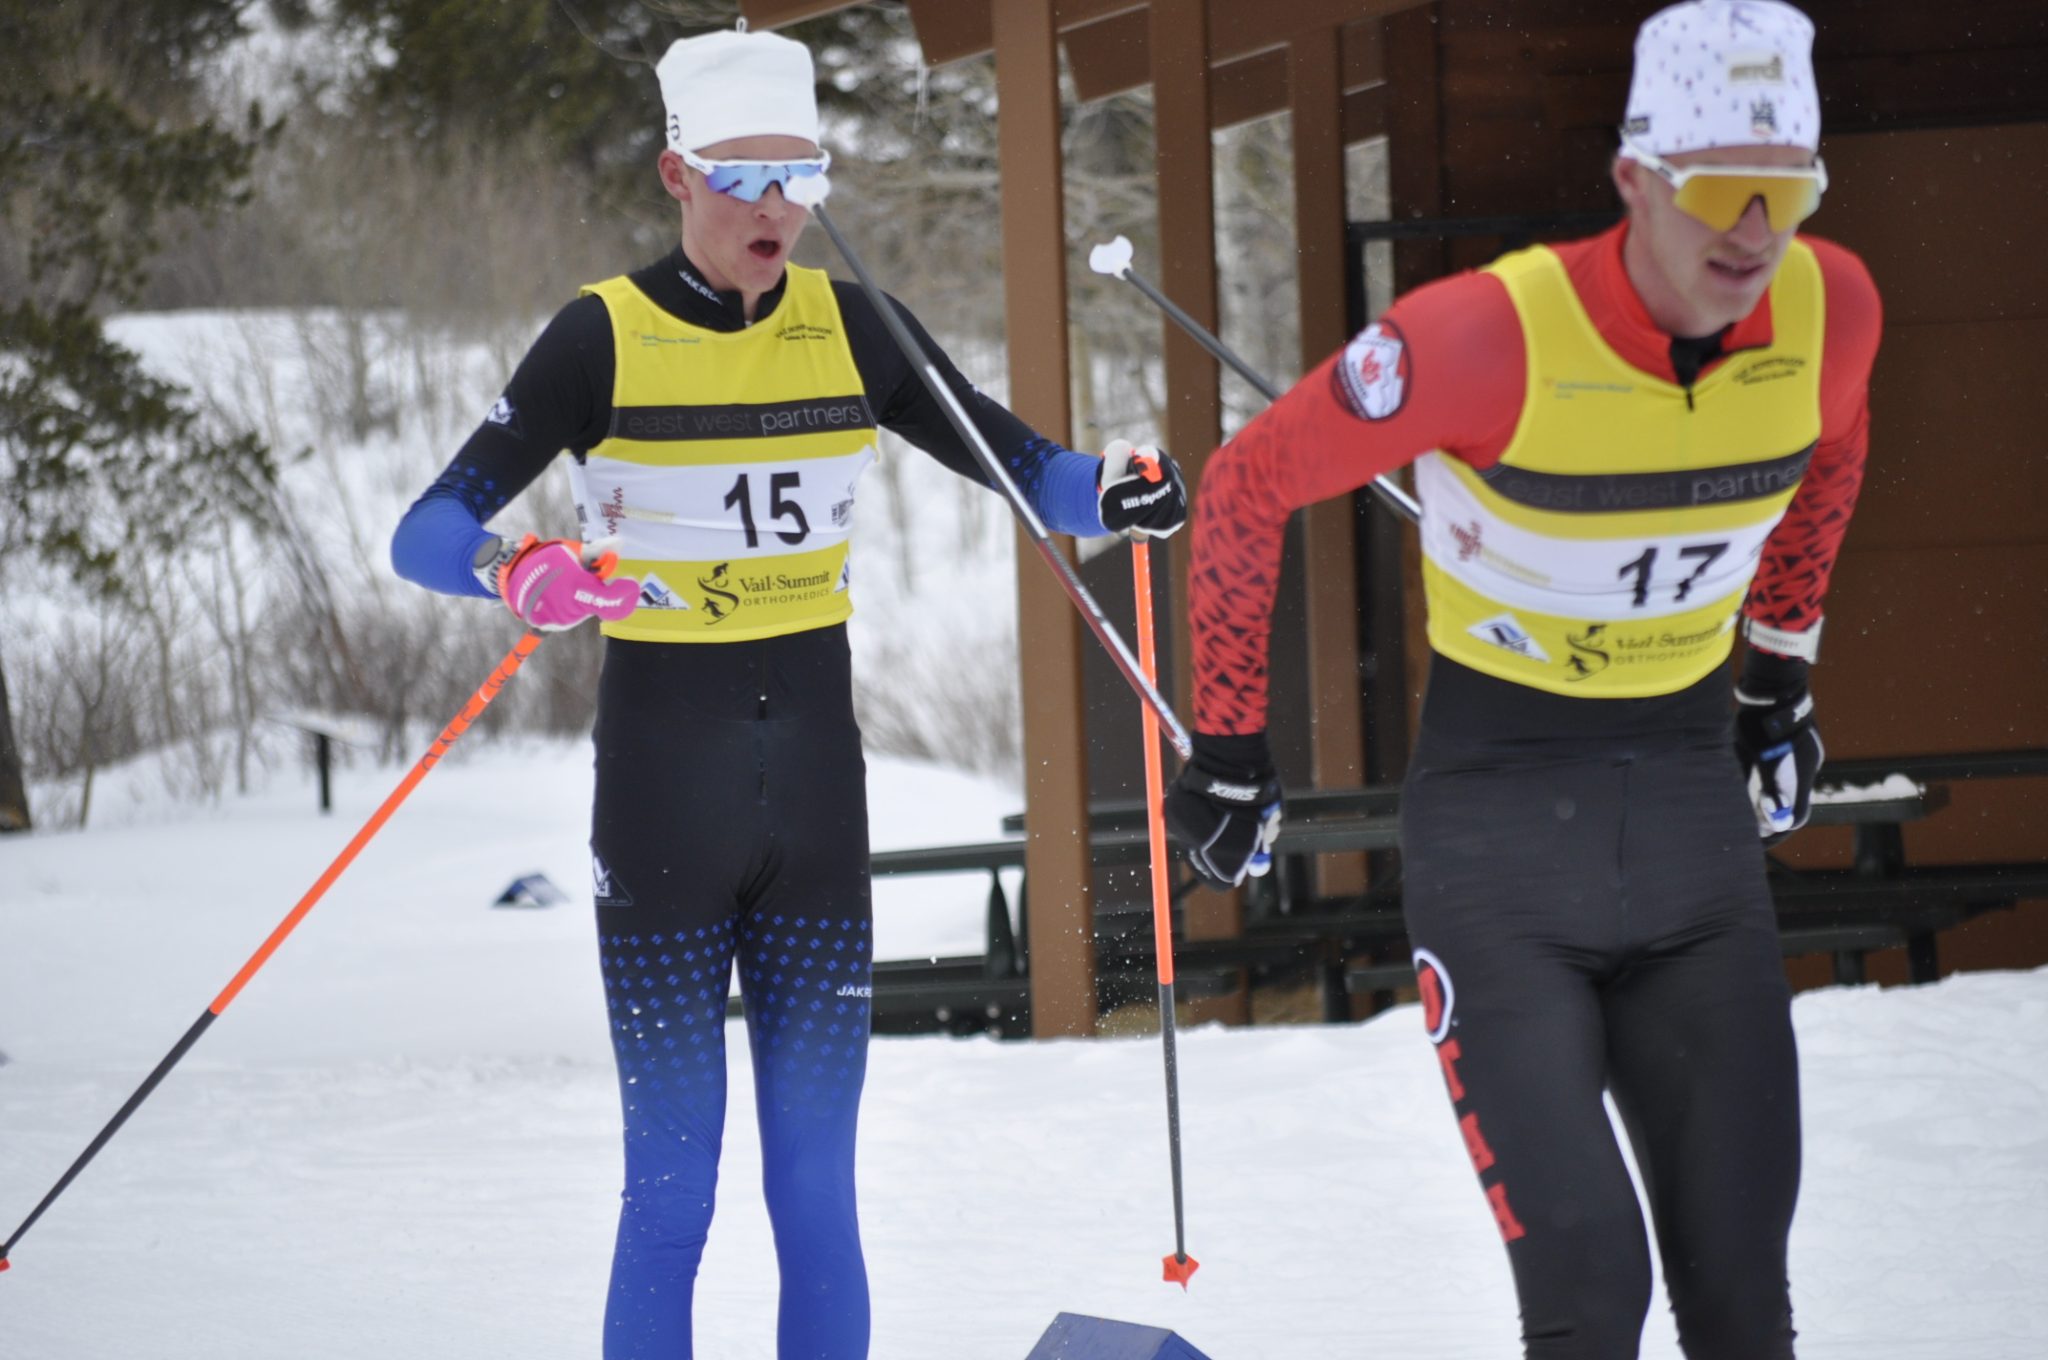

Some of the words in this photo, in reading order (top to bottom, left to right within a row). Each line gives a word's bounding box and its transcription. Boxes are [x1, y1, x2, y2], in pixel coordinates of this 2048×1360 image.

[628, 414, 684, 434] east
[693, 412, 752, 433] west
[759, 403, 862, 436] partners
[723, 472, 811, 549] 15
[743, 588, 830, 607] ORTHOPAEDICS
[1617, 542, 1730, 608] 17
